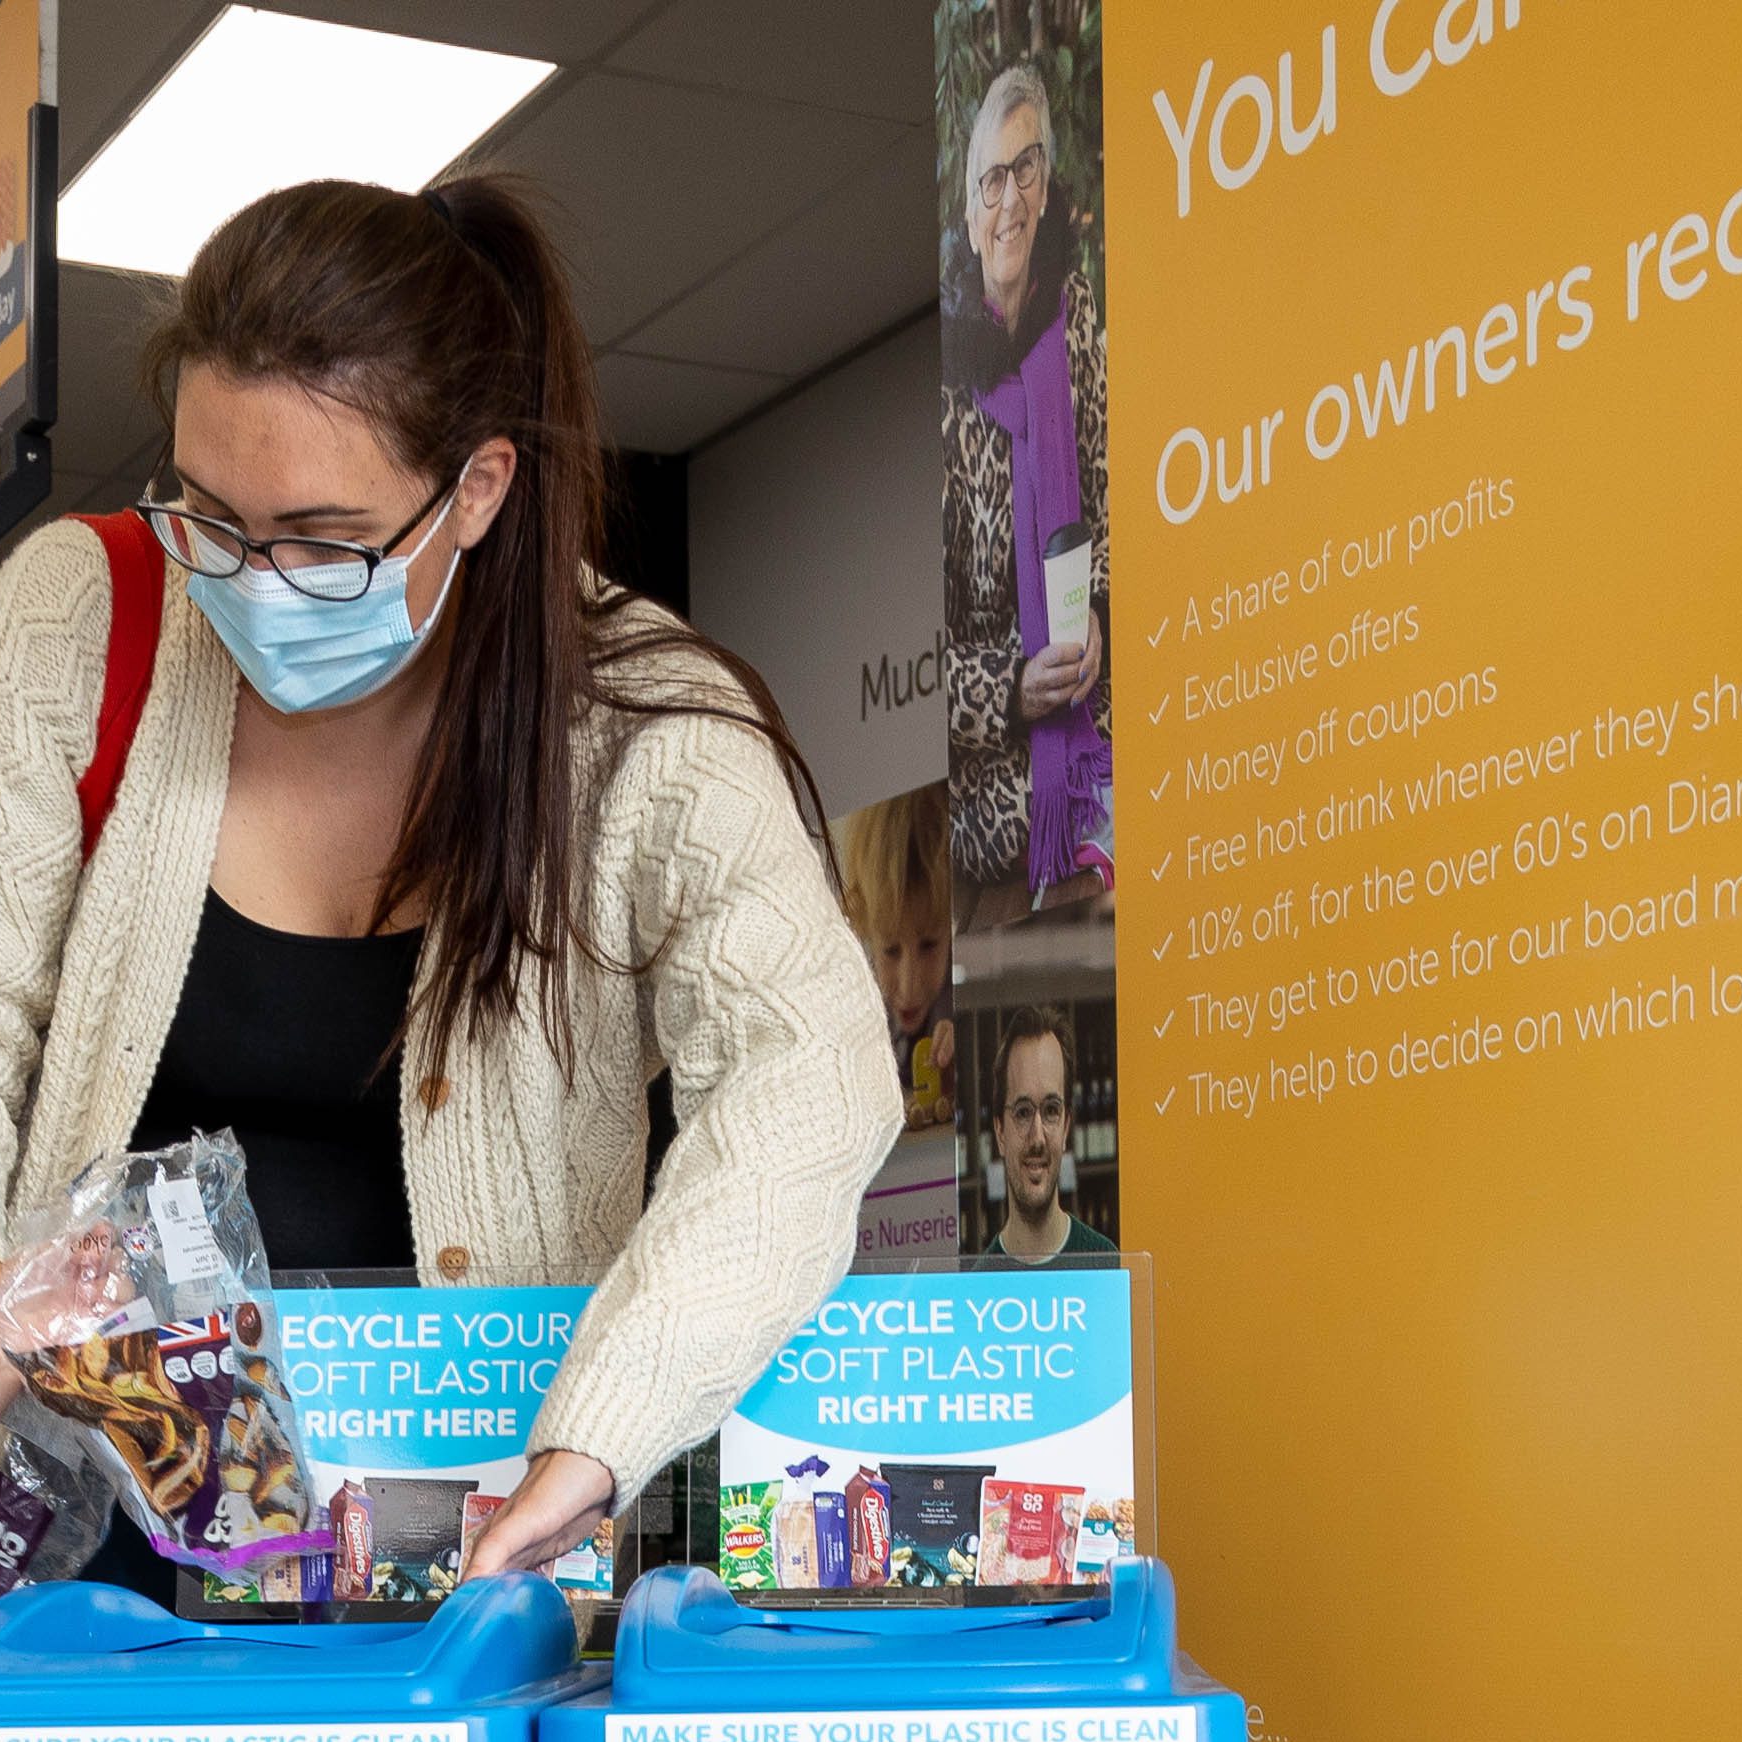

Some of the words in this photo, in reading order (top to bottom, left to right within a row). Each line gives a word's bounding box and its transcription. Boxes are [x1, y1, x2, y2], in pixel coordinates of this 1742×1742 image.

[1153, 24, 1336, 218] You
[1154, 410, 1284, 525] Our
[1302, 264, 1595, 461] owners
[1182, 595, 1203, 641] A
[1210, 570, 1290, 631] share
[1298, 540, 1332, 594] of
[1341, 524, 1397, 577] our
[1408, 477, 1516, 561] profits
[1182, 638, 1318, 722] Exclusive
[1327, 604, 1420, 669] offers
[1185, 737, 1286, 801] Money
[1295, 707, 1340, 764] off
[1347, 665, 1499, 748] coupons
[1186, 832, 1247, 880] Free
[1257, 811, 1307, 861] hot
[1316, 785, 1394, 842] drink
[1404, 730, 1583, 814] whenever
[1593, 699, 1679, 756] they
[1186, 905, 1244, 960] 10%
[1252, 889, 1301, 942] off,
[1309, 881, 1353, 929] for
[1362, 864, 1415, 914] the
[1425, 843, 1503, 896] over
[1512, 815, 1588, 875] 60's
[1599, 805, 1652, 851] on
[1186, 992, 1259, 1040] They
[1268, 976, 1318, 1034] get
[1325, 966, 1359, 1008] to
[1367, 946, 1440, 997] vote
[1449, 930, 1499, 979] for
[1507, 916, 1572, 966] our
[1582, 874, 1698, 951] board
[1187, 1073, 1259, 1120] They
[1269, 1053, 1336, 1106] help
[1346, 1047, 1378, 1087] to
[1388, 1020, 1503, 1080] decide
[1514, 1010, 1563, 1055] on
[1573, 974, 1695, 1042] which
[879, 1215, 957, 1249] Nurserie
[282, 1314, 441, 1349] ECYCLE
[453, 1312, 573, 1347] YOUR
[966, 1297, 1087, 1332] YOUR
[289, 1361, 376, 1397] OFT
[389, 1359, 559, 1396] PLASTIC
[776, 1346, 889, 1384] SOFT
[903, 1344, 1075, 1381] PLASTIC
[305, 1410, 414, 1438] RIGHT
[424, 1408, 516, 1437] HERE
[817, 1395, 928, 1425] RIGHT
[939, 1393, 1034, 1423] HERE
[725, 1532, 764, 1547] WALKERS
[865, 1497, 884, 1560] Digestives
[1041, 1720, 1067, 1742] IS
[1076, 1719, 1180, 1742] CLEAN
